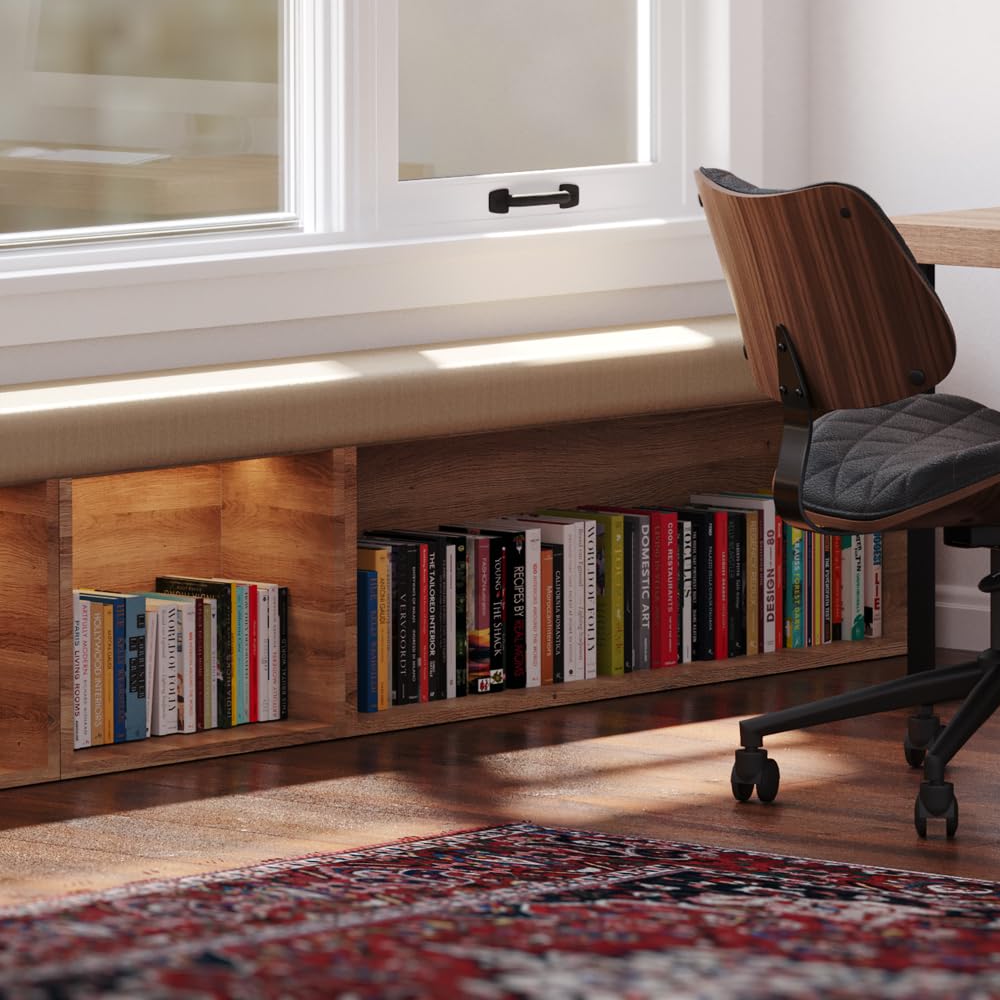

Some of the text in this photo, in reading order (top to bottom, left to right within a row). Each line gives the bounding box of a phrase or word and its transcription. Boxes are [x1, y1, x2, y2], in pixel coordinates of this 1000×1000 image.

[494, 557, 502, 591] YOUNG
[513, 566, 524, 604] RECIPES
[513, 605, 524, 617] BY
[587, 526, 595, 653] WORLD OF FOLLY
[642, 524, 650, 630] DOMESTIC ART
[765, 529, 775, 623] DESIGN 80
[793, 573, 801, 631] FOREST DARK
[94, 612, 102, 728] HOLLYWOOD INTERIORS
[168, 608, 176, 713] WORLD OF FOLLY
[399, 593, 407, 677] VERVOORDT
[493, 600, 503, 657] THE SHACK
